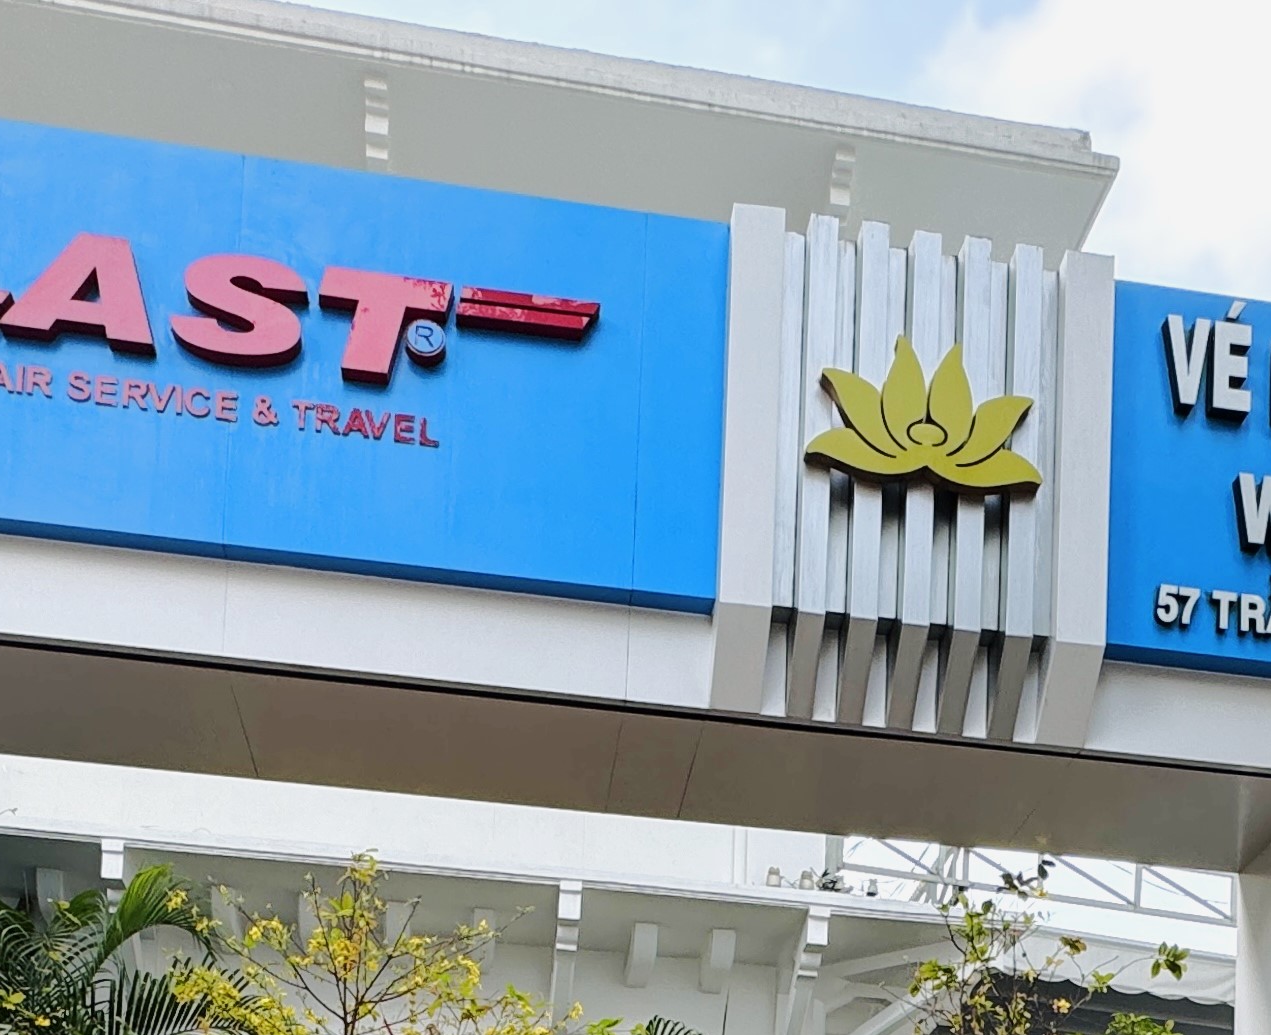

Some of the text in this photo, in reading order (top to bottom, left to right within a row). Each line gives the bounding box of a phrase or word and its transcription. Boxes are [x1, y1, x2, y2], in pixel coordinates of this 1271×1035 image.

[0, 232, 455, 384] AST
[1166, 301, 1253, 414] VÉ
[68, 371, 240, 424] SERVICE
[254, 396, 280, 427] &
[292, 399, 441, 448] TRAVEL
[1156, 583, 1201, 626] 57
